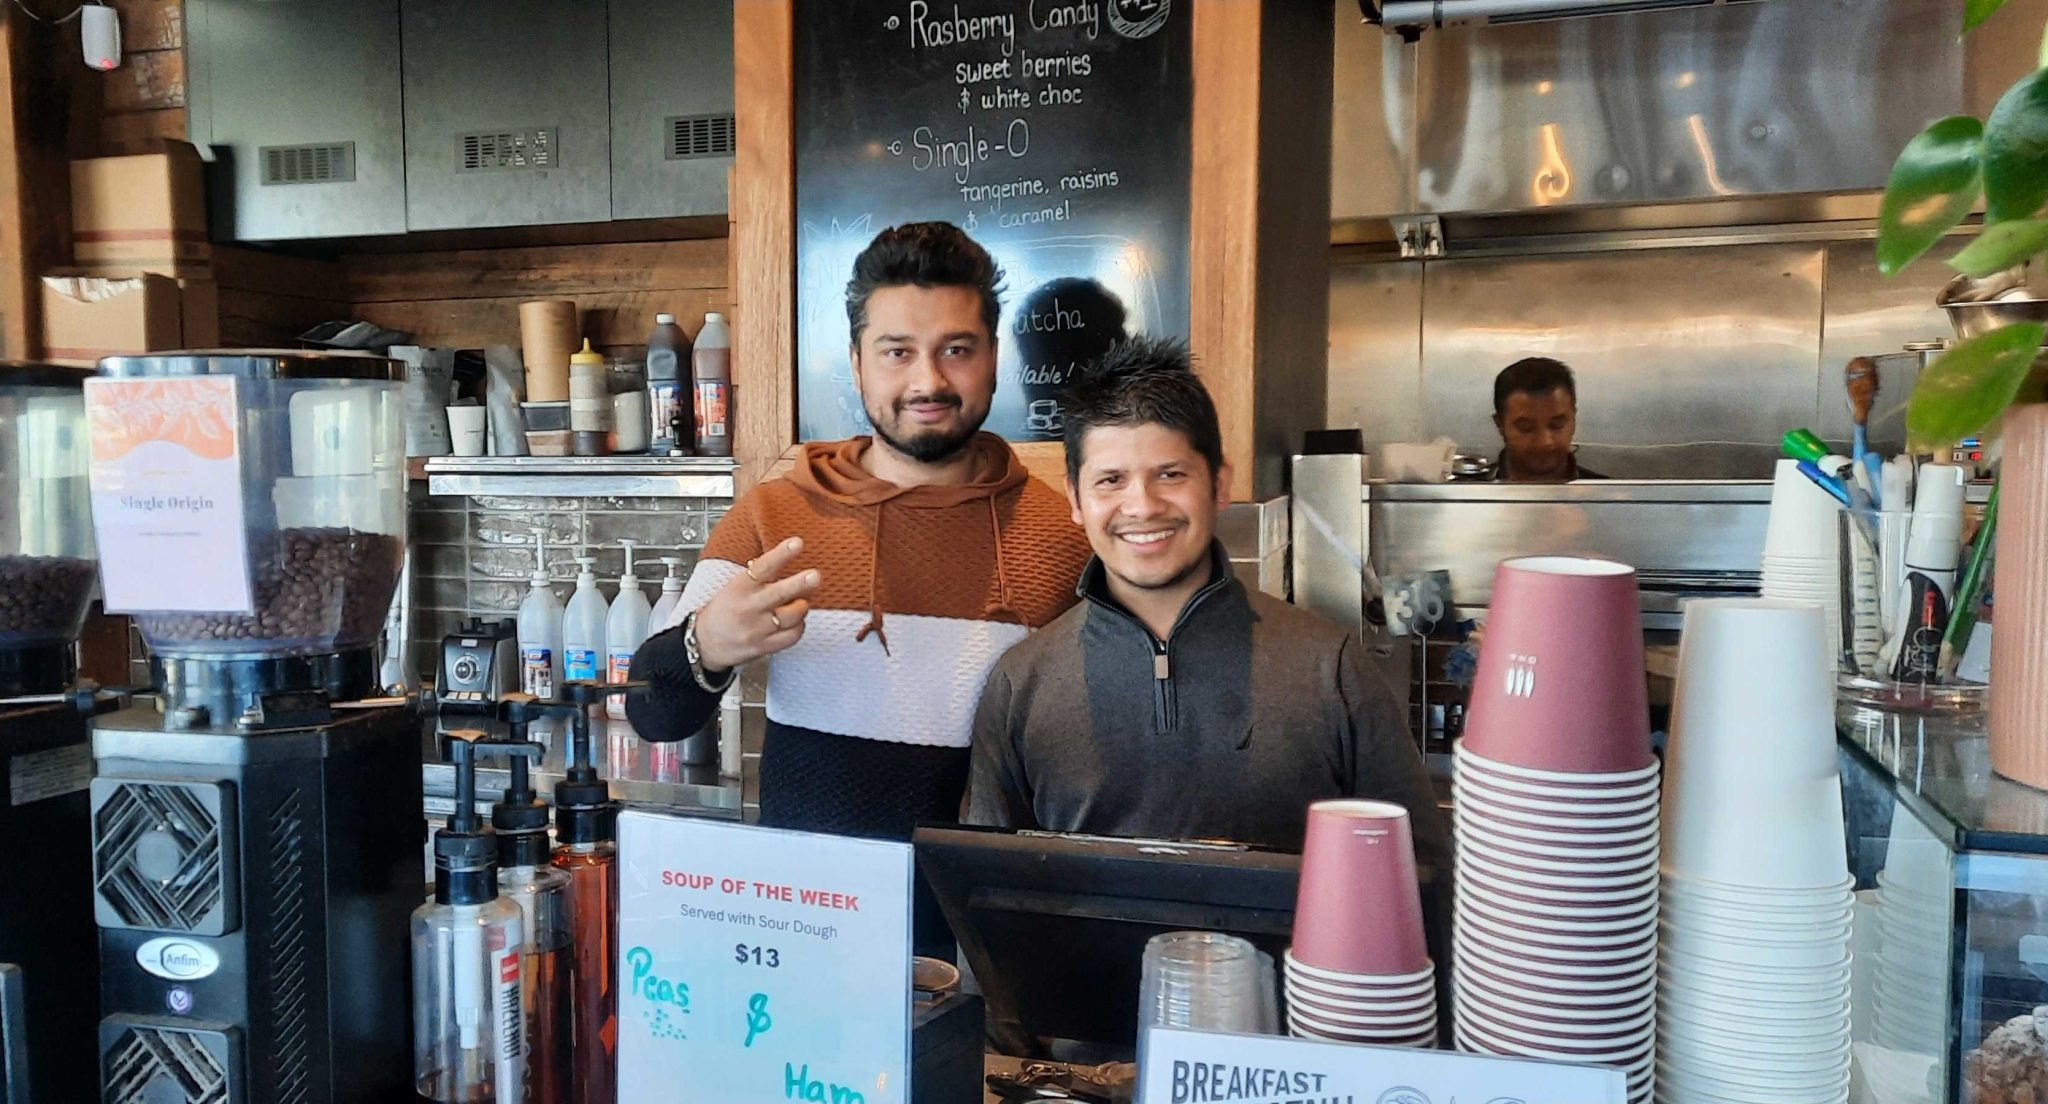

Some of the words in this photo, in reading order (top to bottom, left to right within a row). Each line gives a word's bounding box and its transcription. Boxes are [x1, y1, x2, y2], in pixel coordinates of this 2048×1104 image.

[909, 0, 1016, 58] Rasberry
[1028, 0, 1100, 41] Candy
[955, 57, 1013, 85] sweet
[1021, 48, 1093, 79] berries
[981, 84, 1033, 110] white
[1039, 82, 1083, 106] choc
[912, 118, 1030, 185] Single-O
[960, 176, 1050, 212] tangerine,
[1060, 168, 1120, 192] raisins
[999, 199, 1071, 228] caramel
[120, 496, 164, 511] Single
[168, 496, 213, 512] Origin
[662, 871, 714, 891] SOUP
[720, 878, 746, 895] OF
[753, 883, 793, 902] THE
[800, 889, 860, 912] WEEK
[680, 903, 725, 922] Served
[727, 911, 756, 927] with
[758, 915, 790, 931] Sour
[793, 920, 838, 940] Dough
[166, 953, 200, 967] Anfim
[735, 943, 780, 968] $13
[627, 946, 690, 1008] Peas
[785, 1061, 865, 1104] Ham
[1171, 1059, 1327, 1104] BREAKFAST
